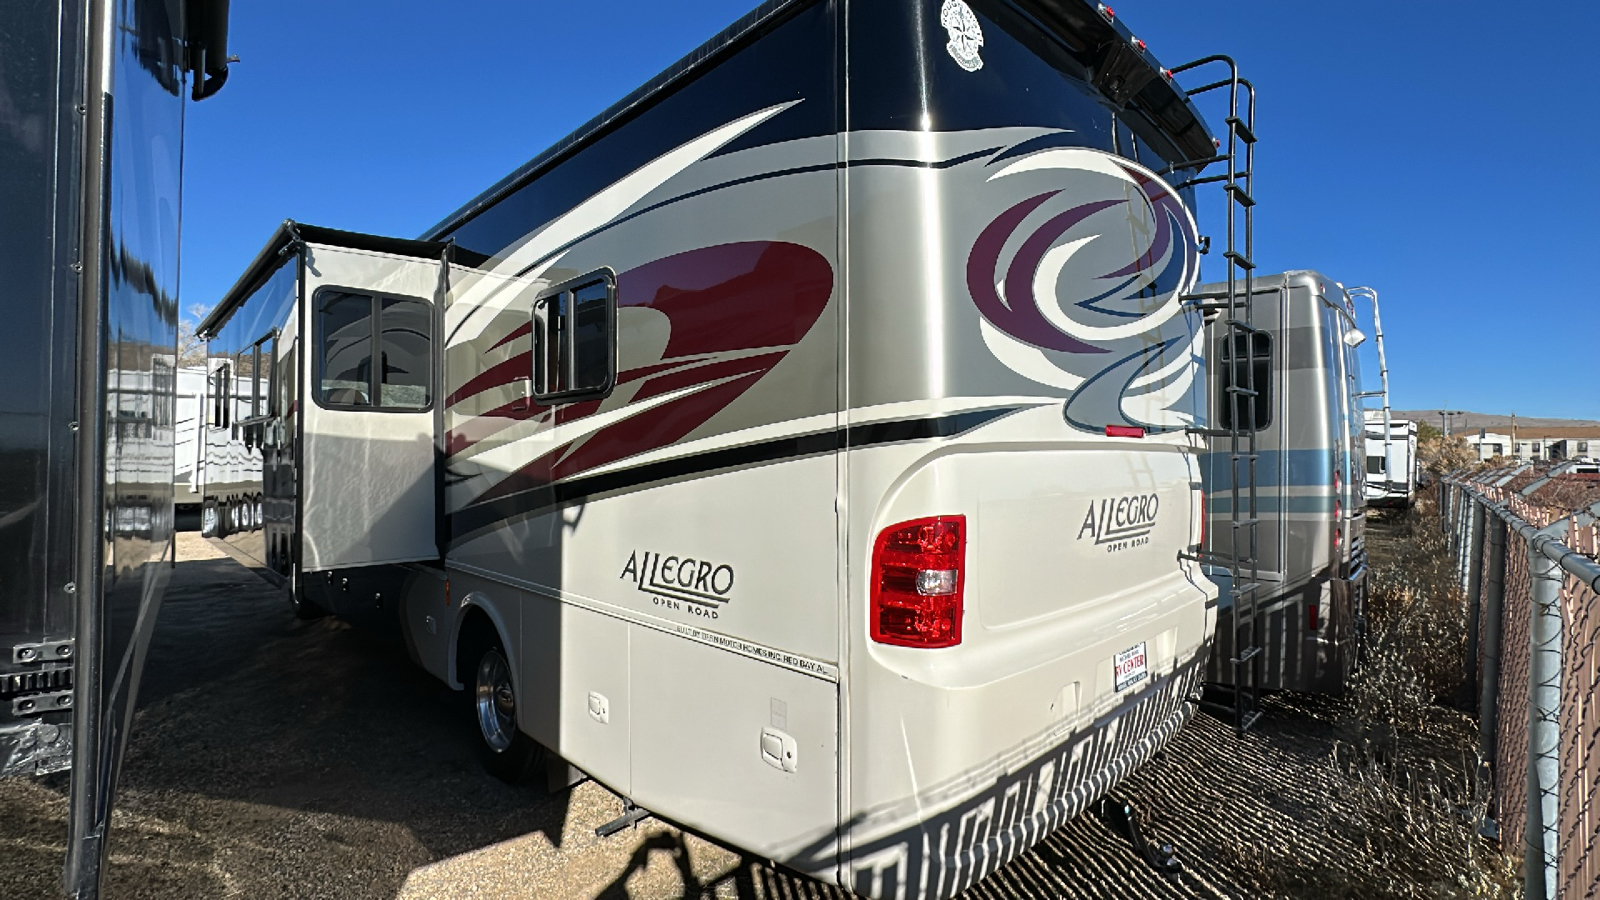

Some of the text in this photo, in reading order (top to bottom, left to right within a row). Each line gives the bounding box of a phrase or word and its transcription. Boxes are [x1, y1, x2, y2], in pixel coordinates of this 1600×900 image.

[1076, 492, 1159, 545] ALLEGRO
[1107, 536, 1150, 553] OPEN ROAD
[619, 549, 734, 608] ALLEGRO
[652, 596, 719, 620] OPEN ROAD
[719, 637, 742, 651] MOTOR
[742, 643, 768, 658] HOMES
[783, 654, 799, 666] RED
[799, 659, 815, 672] BAY
[1122, 653, 1144, 674] CENTER
